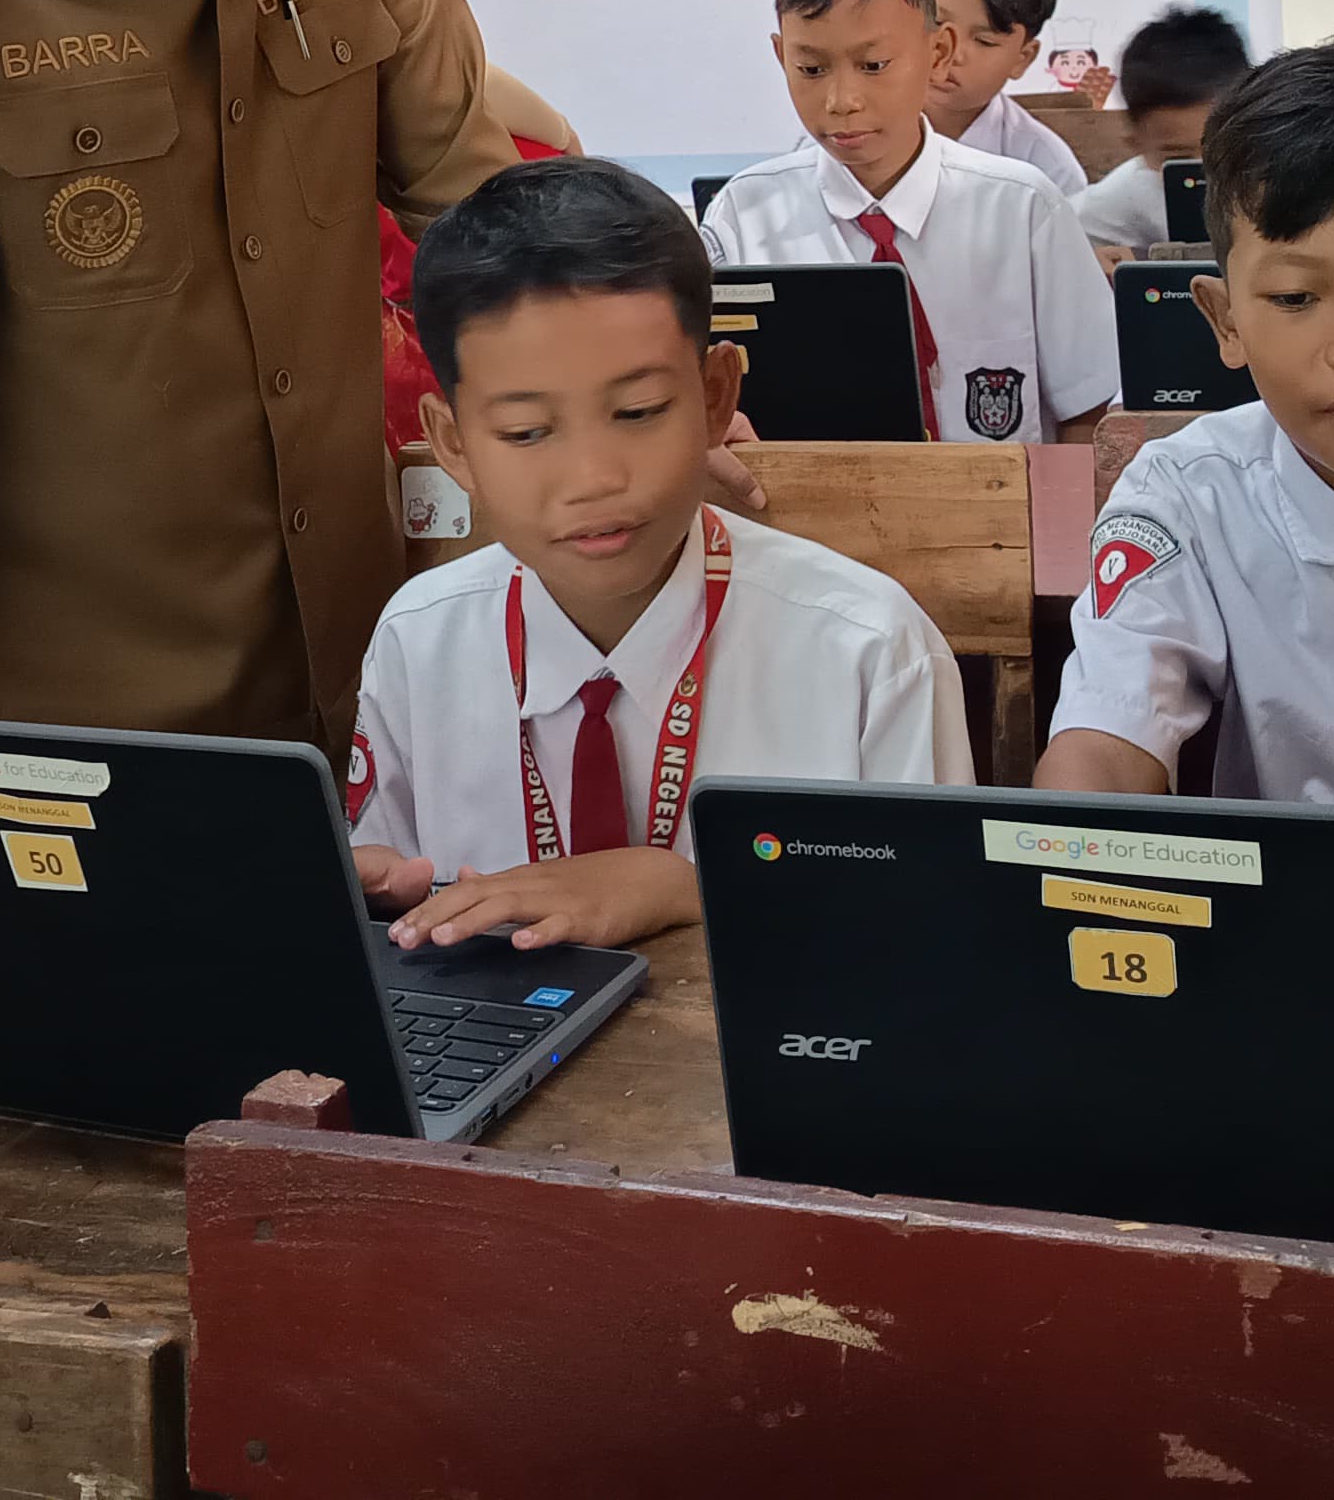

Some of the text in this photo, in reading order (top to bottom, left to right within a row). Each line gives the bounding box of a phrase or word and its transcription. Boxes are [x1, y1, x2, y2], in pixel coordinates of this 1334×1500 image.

[0, 29, 152, 79] BARRA
[1162, 290, 1193, 300] chrom
[1153, 389, 1202, 403] acer
[3, 756, 25, 775] for
[28, 759, 105, 786] Education
[650, 701, 693, 846] SD NEGERI
[28, 850, 64, 877] 50
[786, 838, 897, 861] chromebook
[1015, 829, 1256, 869] Google for Education
[1071, 891, 1182, 915] SDN MENANGGAL
[1099, 950, 1149, 984] 18
[778, 1033, 872, 1062] acer
